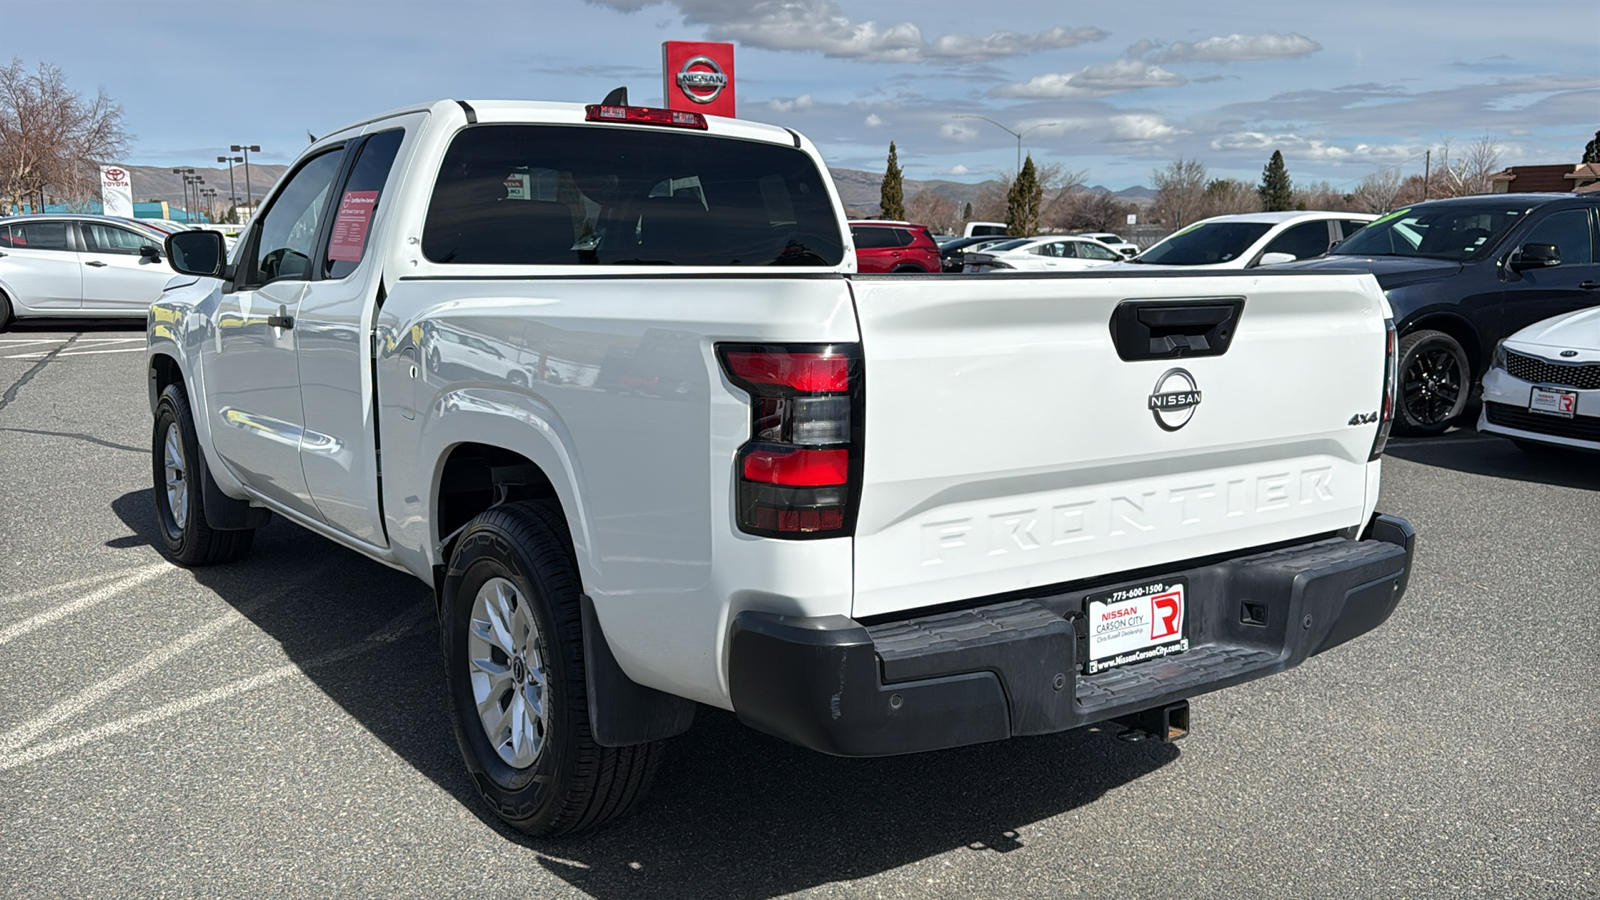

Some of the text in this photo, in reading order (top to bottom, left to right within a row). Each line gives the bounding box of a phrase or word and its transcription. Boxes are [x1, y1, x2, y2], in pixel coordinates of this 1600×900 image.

[682, 75, 724, 83] NISSAN
[1151, 392, 1201, 407] NISSAN
[1562, 397, 1573, 411] R
[920, 466, 1335, 567] FRONTIER
[1112, 583, 1163, 602] 775-600-1500
[1101, 606, 1137, 622] NISSAN
[1154, 597, 1179, 635] R
[1096, 615, 1144, 634] CARSON CITY
[1096, 628, 1144, 644] Chris Russell Dealership
[1097, 644, 1181, 670] www.NissanCarsonCity.com
